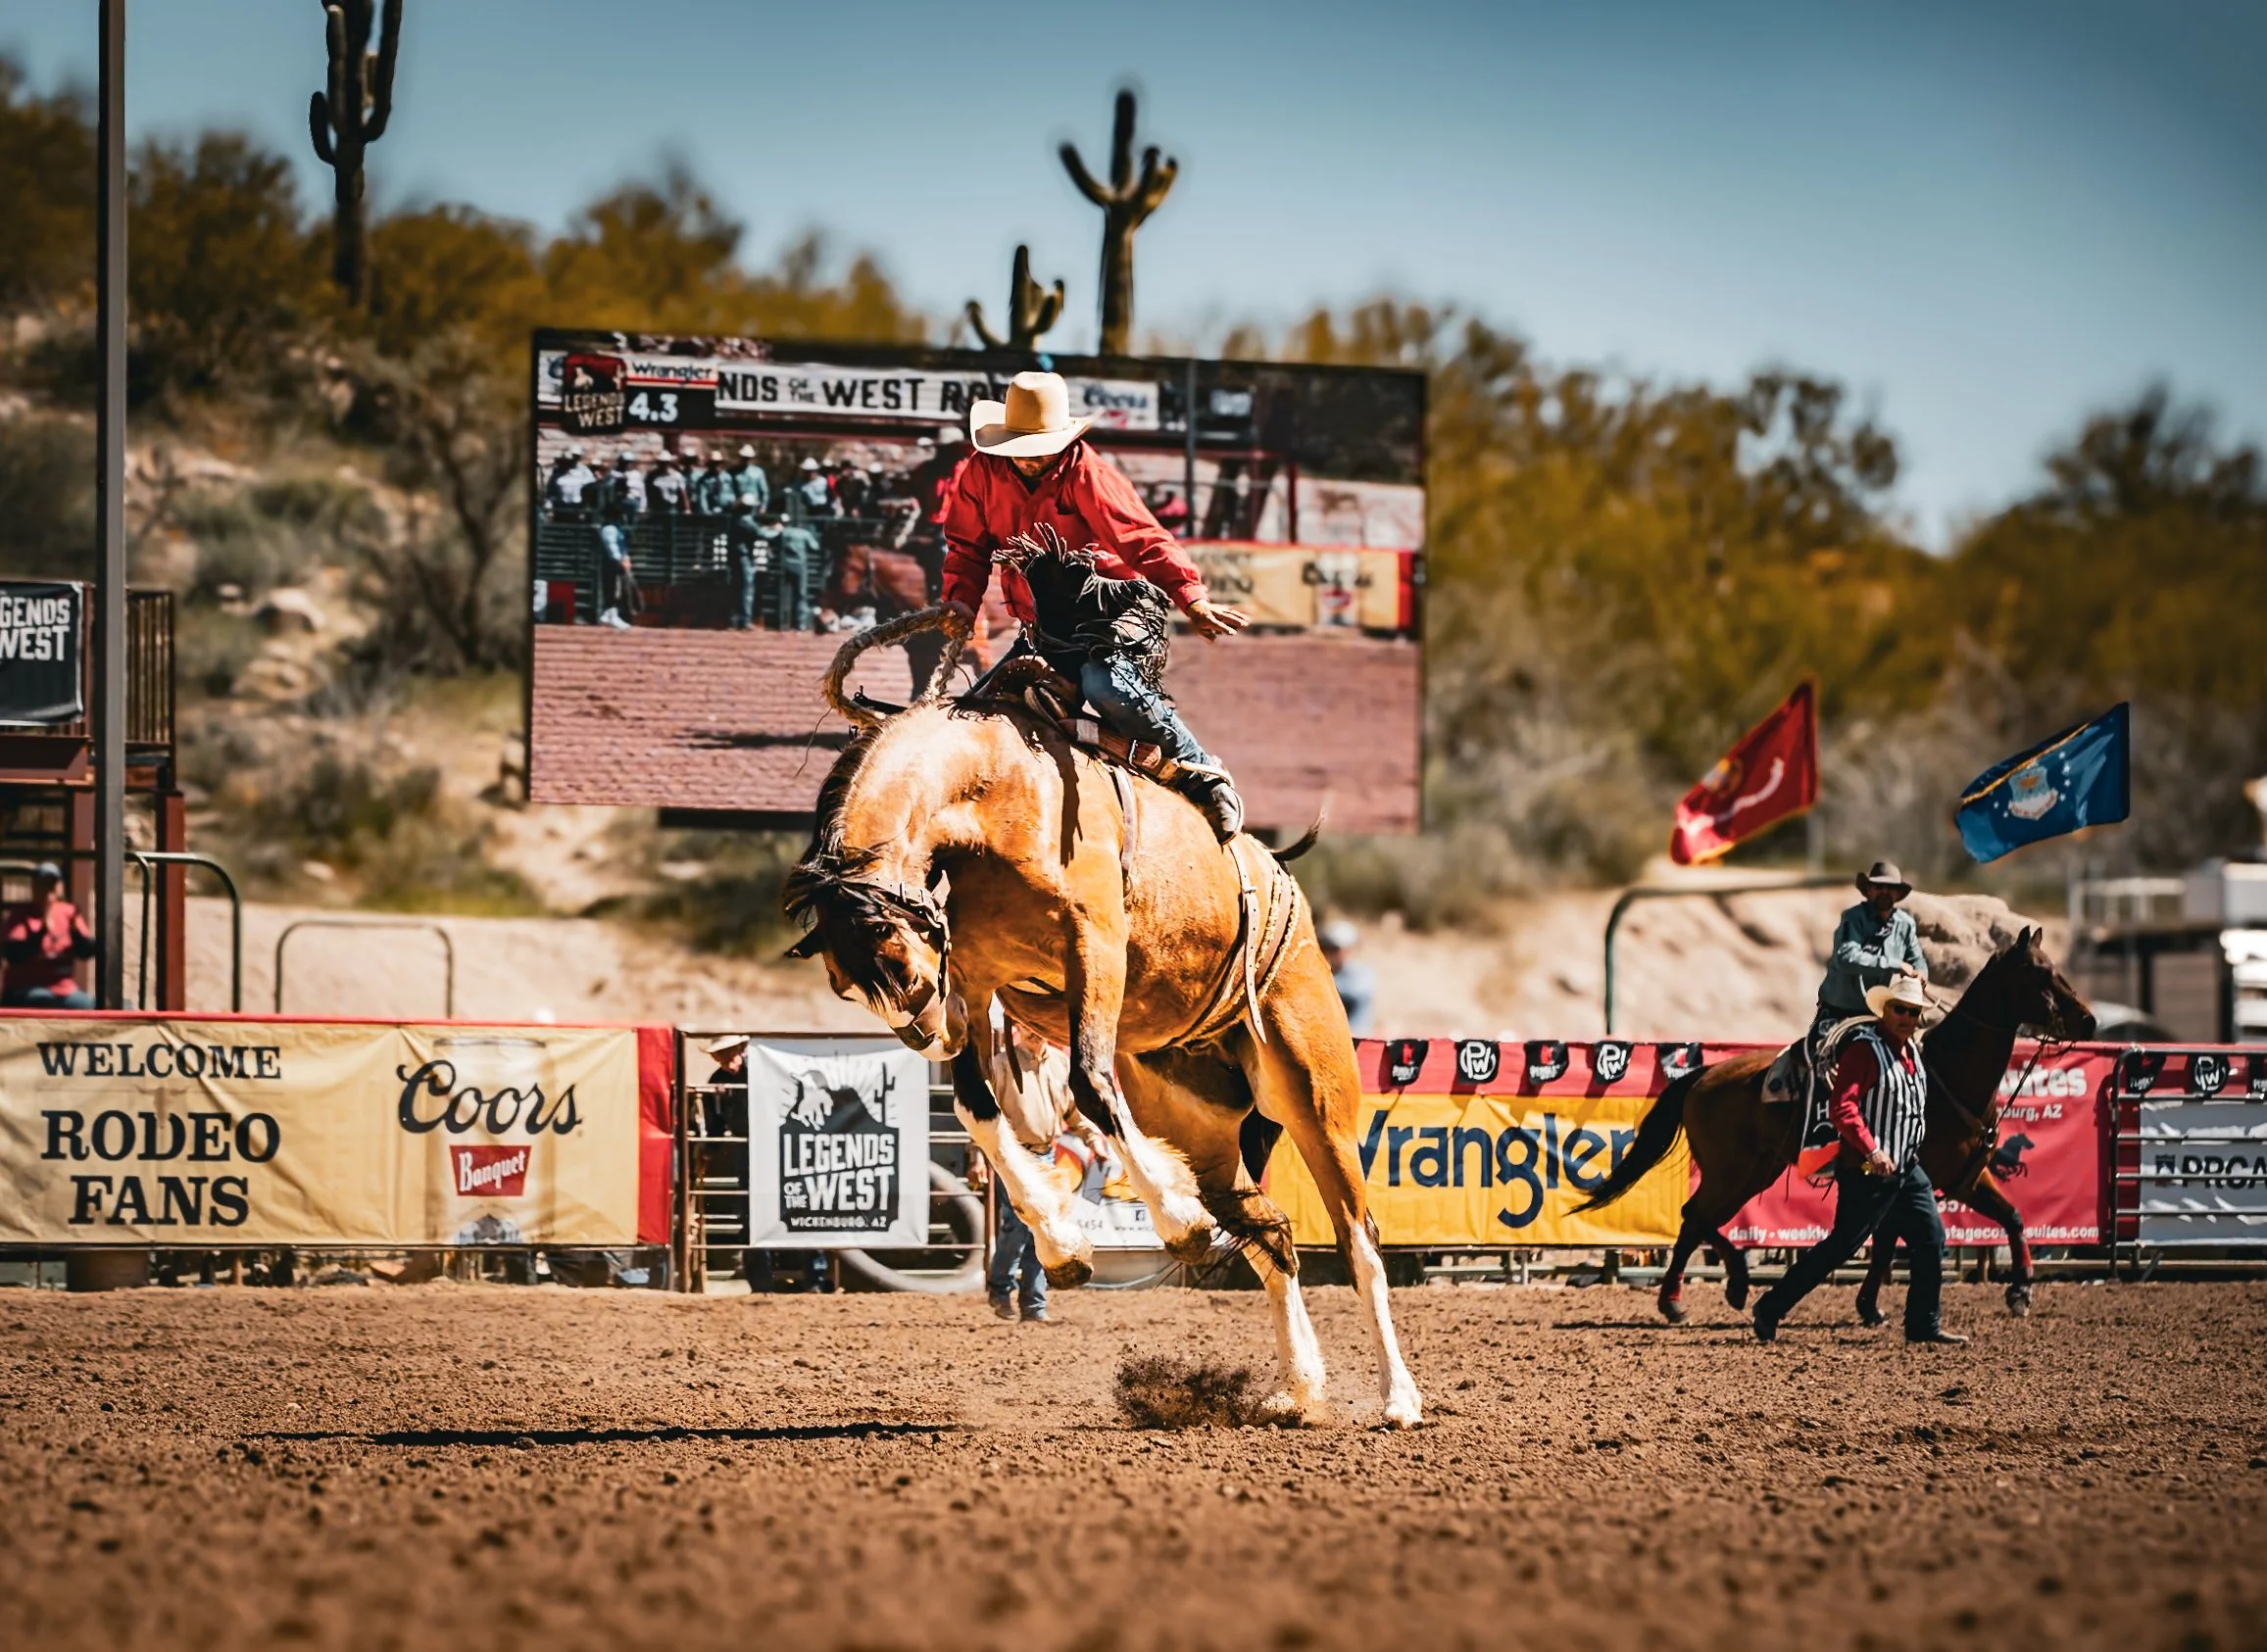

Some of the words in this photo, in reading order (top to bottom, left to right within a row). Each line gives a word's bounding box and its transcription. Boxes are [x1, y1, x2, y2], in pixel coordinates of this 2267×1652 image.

[628, 392, 678, 422] 4.3
[719, 372, 778, 402] NDS
[822, 378, 925, 411] WEST
[578, 406, 624, 427] WEST
[36, 1042, 281, 1079] WELCOME
[1997, 1060, 2088, 1096] uites
[396, 1059, 582, 1135] Coors
[1996, 1103, 2039, 1122] burg,
[2042, 1102, 2063, 1118] AZ
[40, 1110, 281, 1163] RODEO
[458, 1150, 526, 1191] Banquet
[783, 1133, 895, 1177] LEGENDS
[68, 1175, 250, 1227] FANS
[783, 1182, 804, 1195] OF
[784, 1194, 809, 1209] THE
[805, 1166, 895, 1211] WEST
[871, 1216, 887, 1228] AZ
[1728, 1225, 1767, 1244] daily
